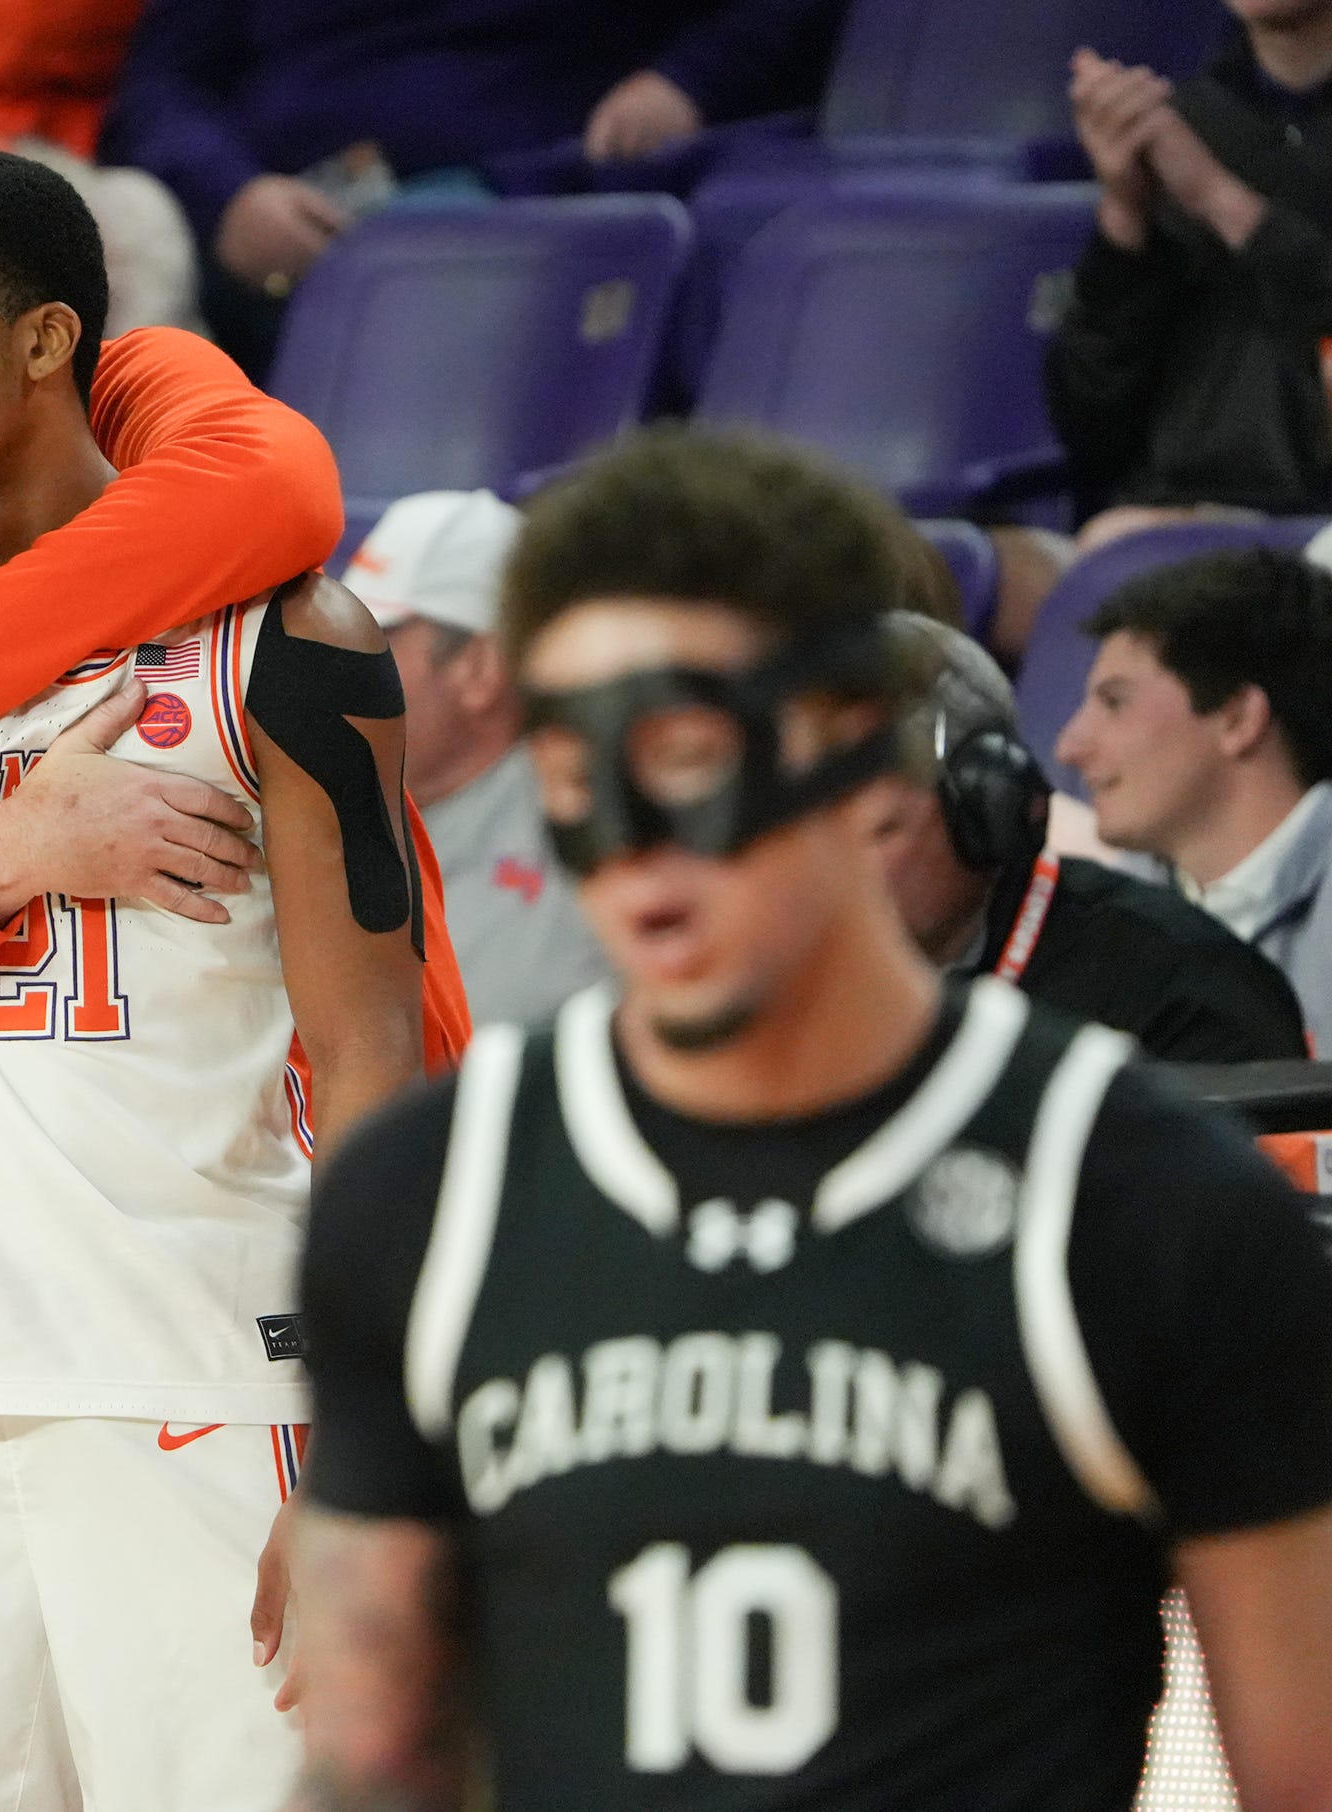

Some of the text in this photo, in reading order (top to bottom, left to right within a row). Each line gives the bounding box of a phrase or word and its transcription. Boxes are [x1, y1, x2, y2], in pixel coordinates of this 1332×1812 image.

[143, 710, 187, 724] ACC
[457, 1330, 1017, 1529] CAROLINA
[607, 1543, 841, 1775] 10
